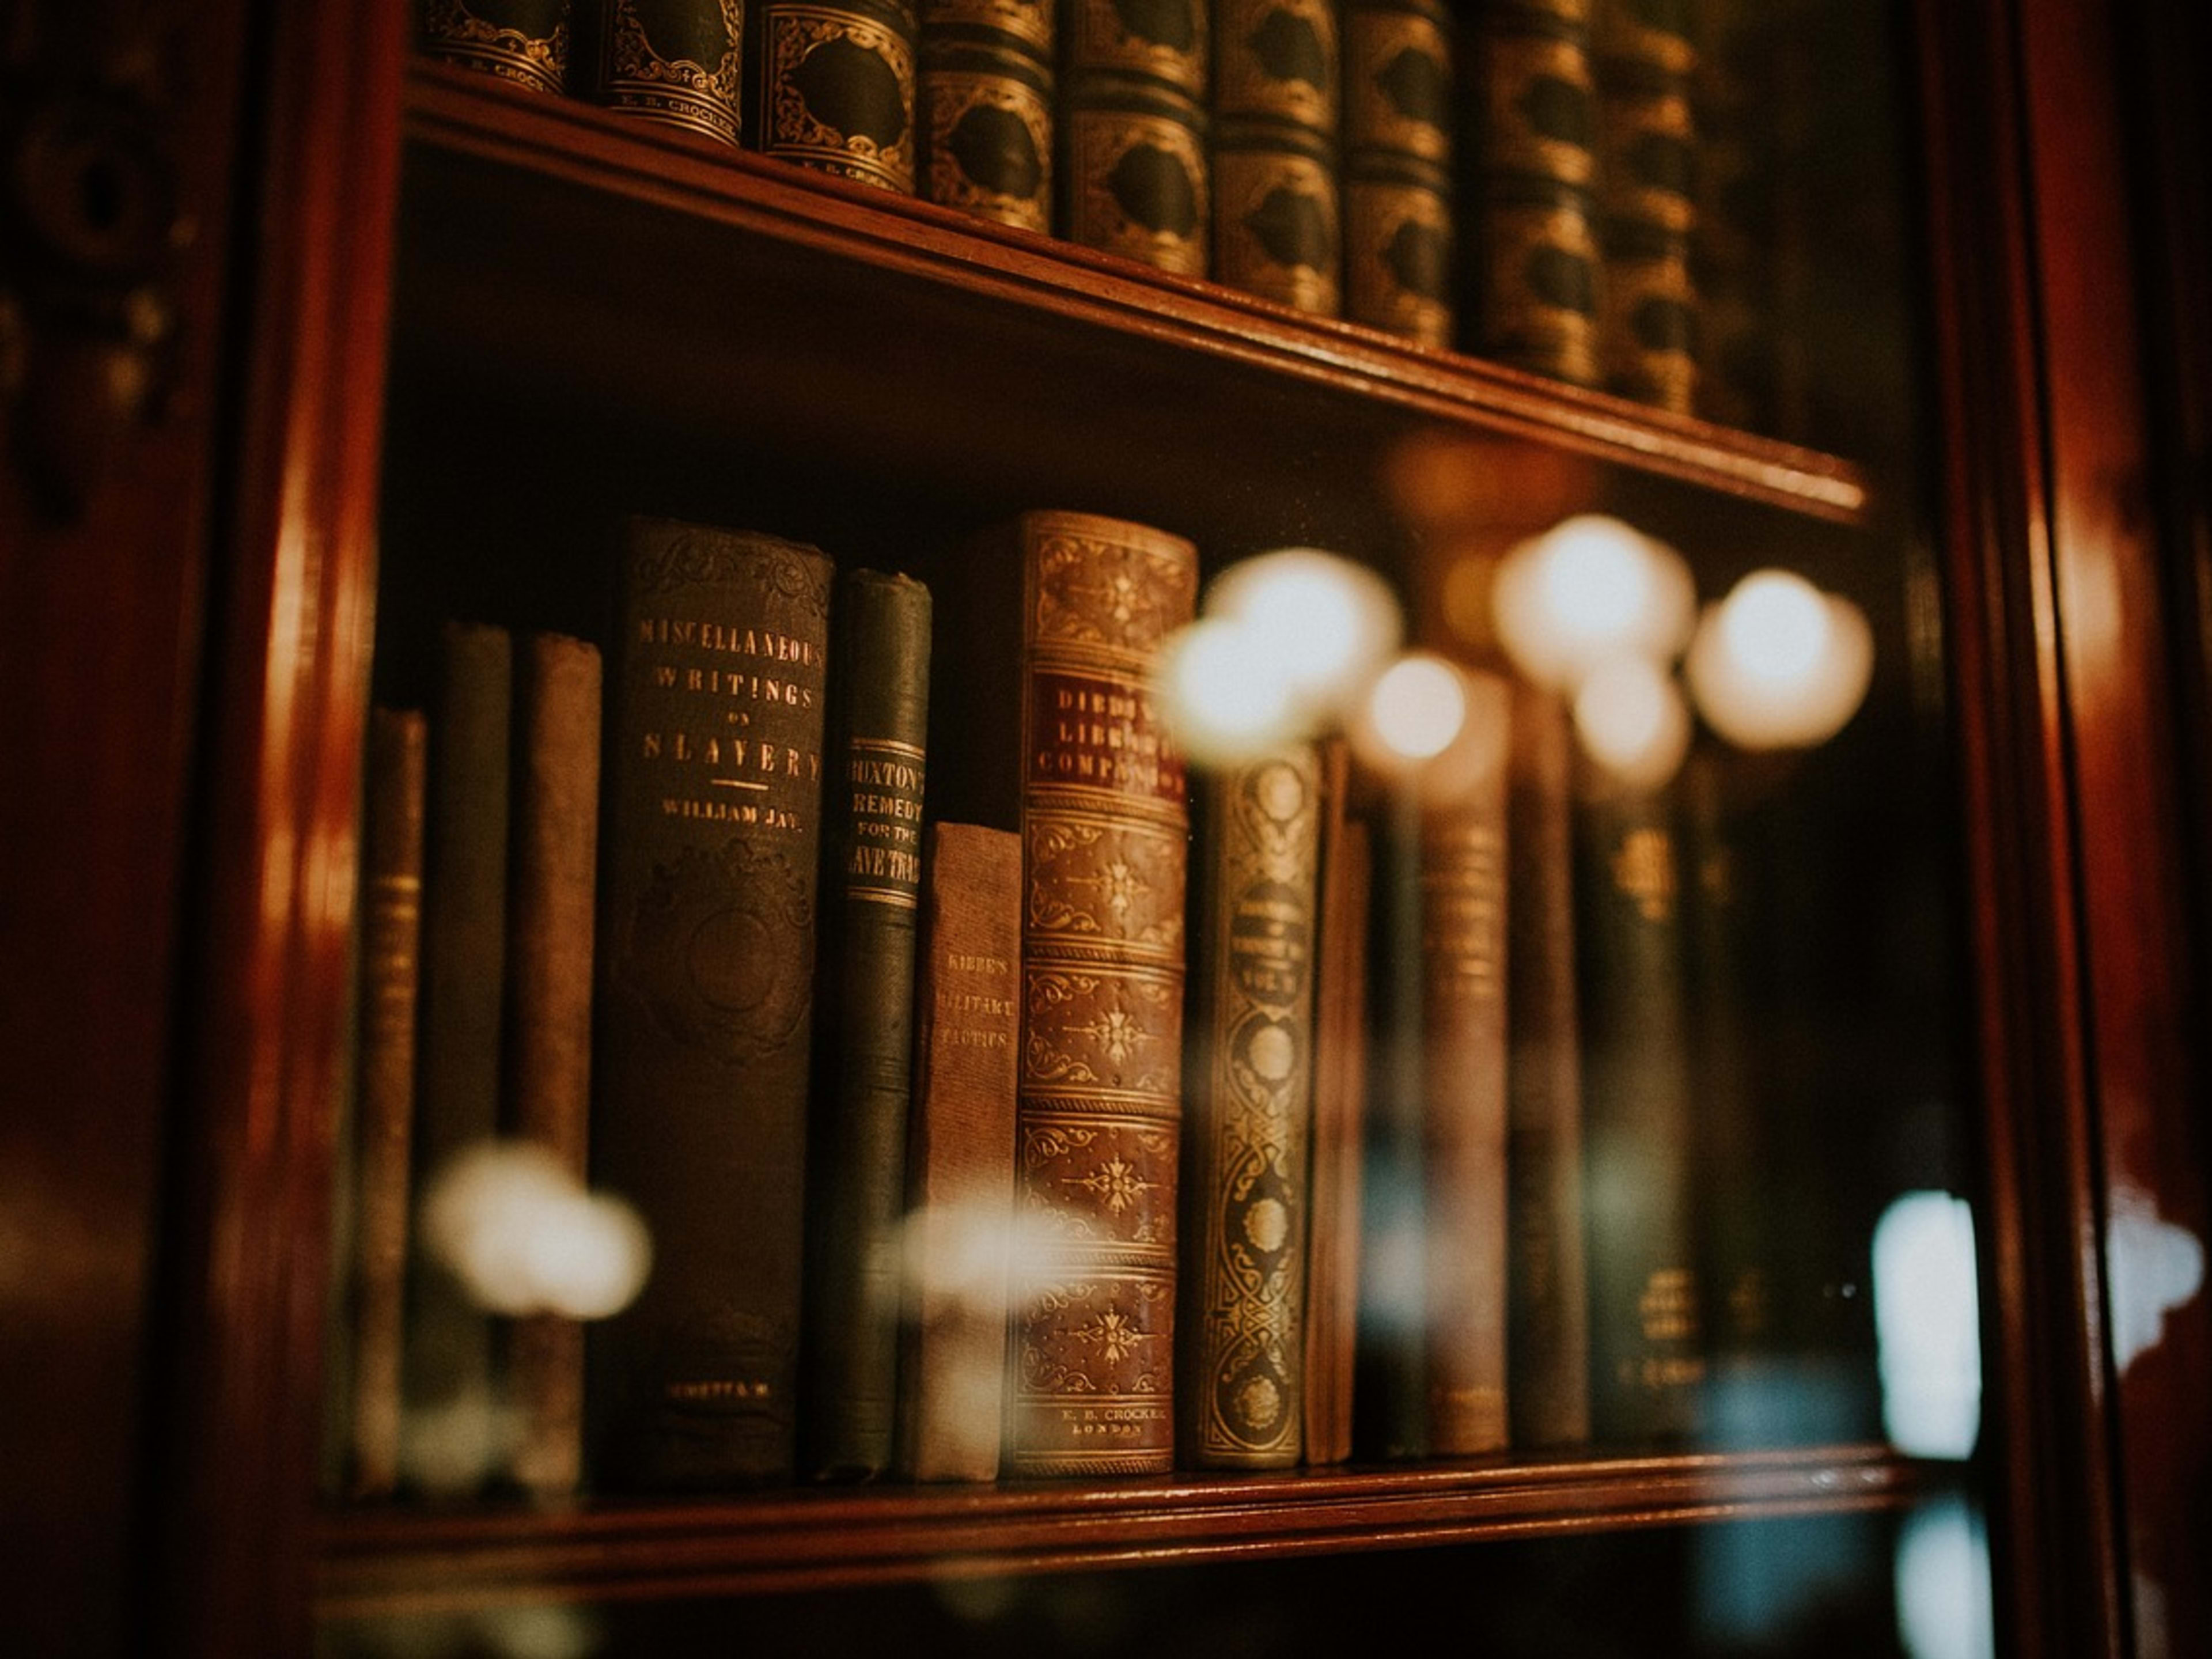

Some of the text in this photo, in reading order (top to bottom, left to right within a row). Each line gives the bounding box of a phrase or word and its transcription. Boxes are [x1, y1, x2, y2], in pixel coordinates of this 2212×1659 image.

[494, 65, 544, 92] CROCK
[656, 666, 813, 709] WRITINGS
[728, 711, 750, 726] ON
[643, 732, 820, 781] SLAVERY
[662, 798, 758, 824] WILLIAM
[853, 793, 923, 823] REMEDY
[857, 821, 918, 845] FOR THE
